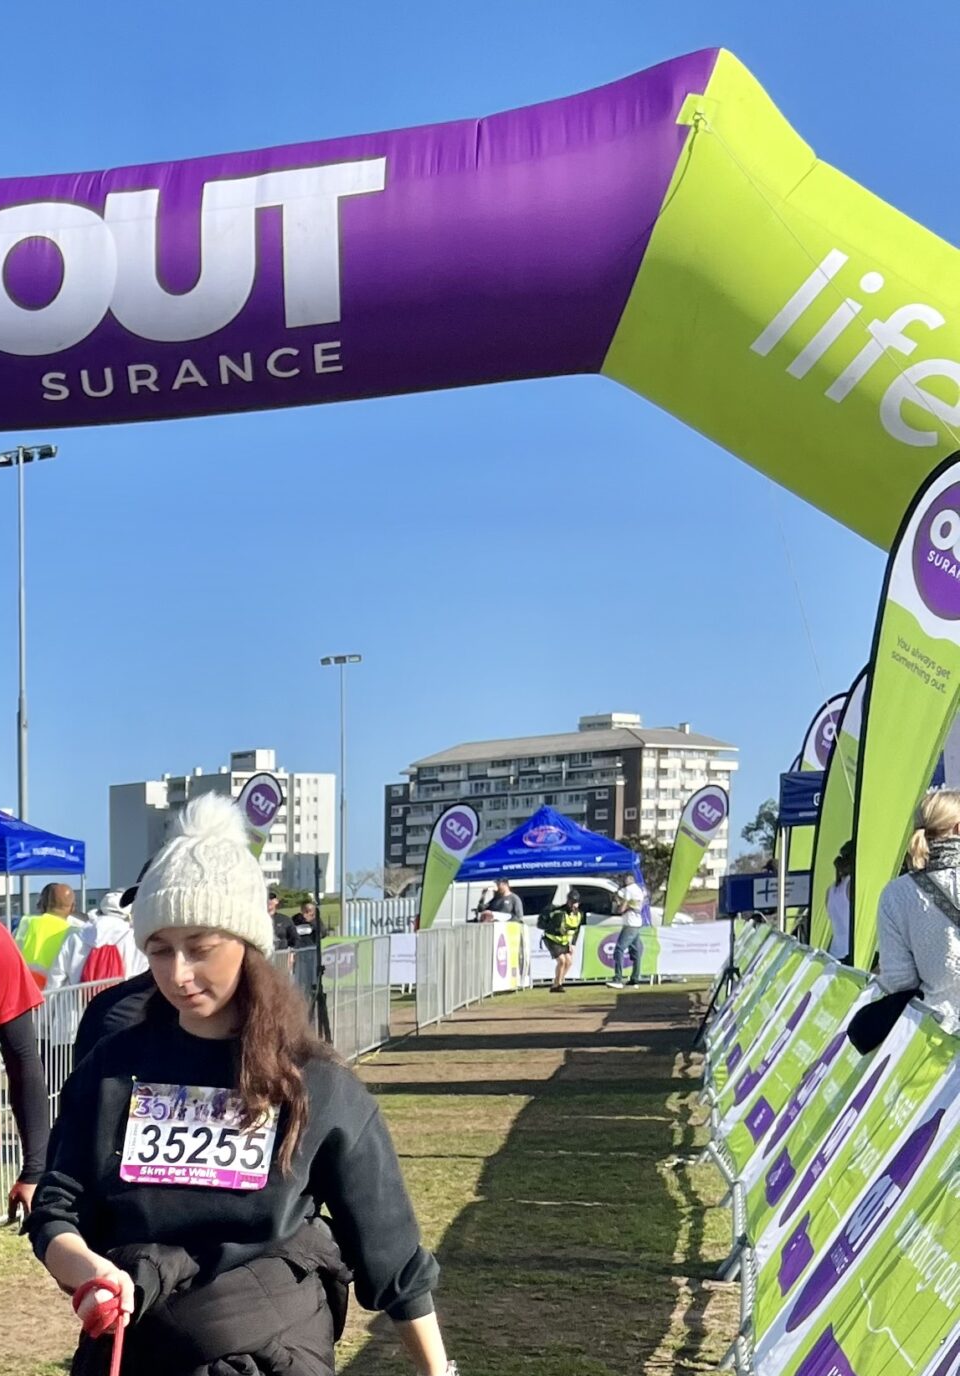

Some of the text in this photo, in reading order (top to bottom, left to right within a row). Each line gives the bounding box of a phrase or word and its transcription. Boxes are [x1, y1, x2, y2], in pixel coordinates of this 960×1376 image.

[750, 248, 960, 447] life
[40, 340, 344, 402] SURANCE
[250, 791, 276, 815] OUT
[696, 800, 722, 823] OUT
[445, 818, 471, 840] OUT
[168, 1166, 187, 1177] Pet
[189, 1168, 218, 1179] Walk
